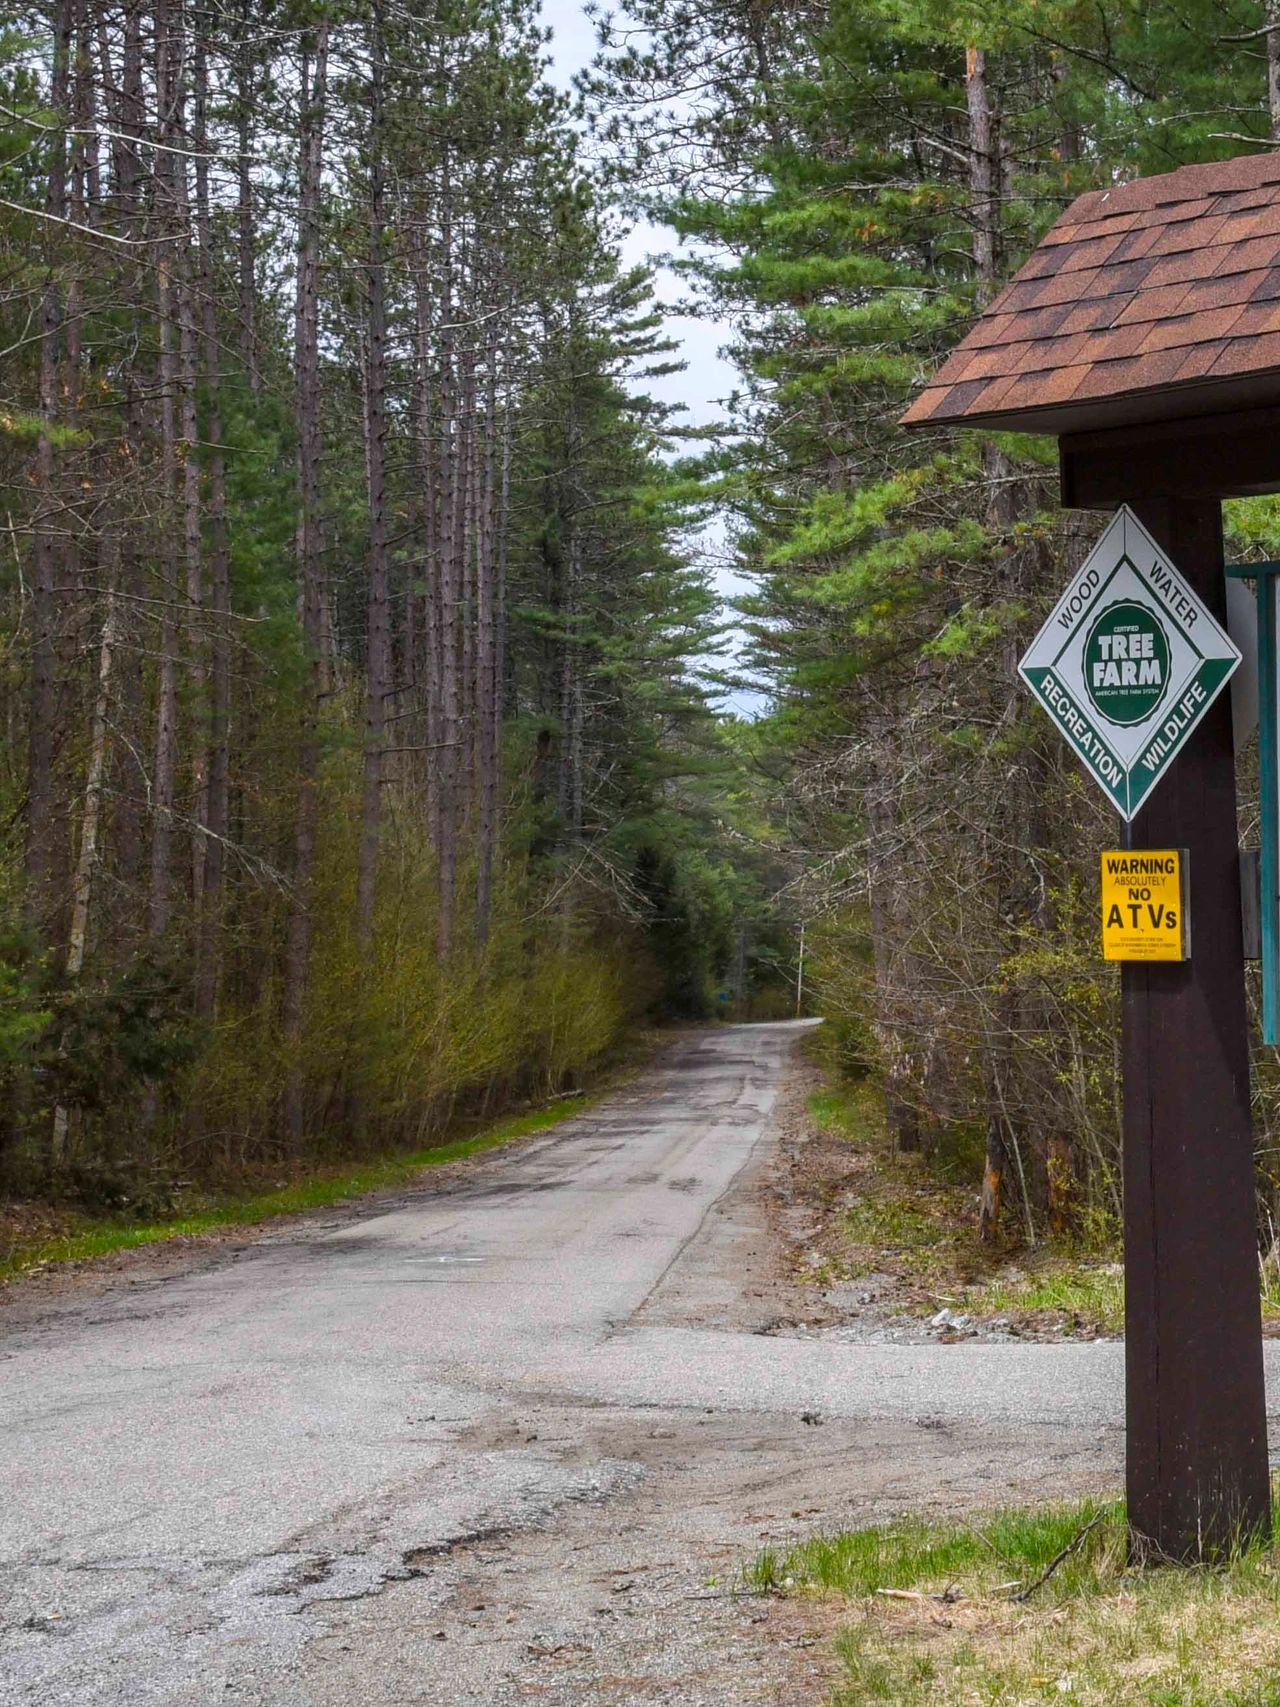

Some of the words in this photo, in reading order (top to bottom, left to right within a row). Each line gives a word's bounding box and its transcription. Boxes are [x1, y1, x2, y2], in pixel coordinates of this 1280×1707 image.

[1058, 569, 1100, 629] WOOD
[1150, 561, 1198, 628] WATER
[1098, 633, 1154, 660] TREE
[1093, 659, 1161, 687] FARM
[1040, 675, 1122, 788] RECREATION
[1143, 681, 1207, 772] WILDLIFE
[1107, 859, 1175, 874] WARNING
[1114, 876, 1167, 886] ABSOLUTELY
[1128, 888, 1151, 901] NO
[1107, 904, 1177, 929] ATVs
